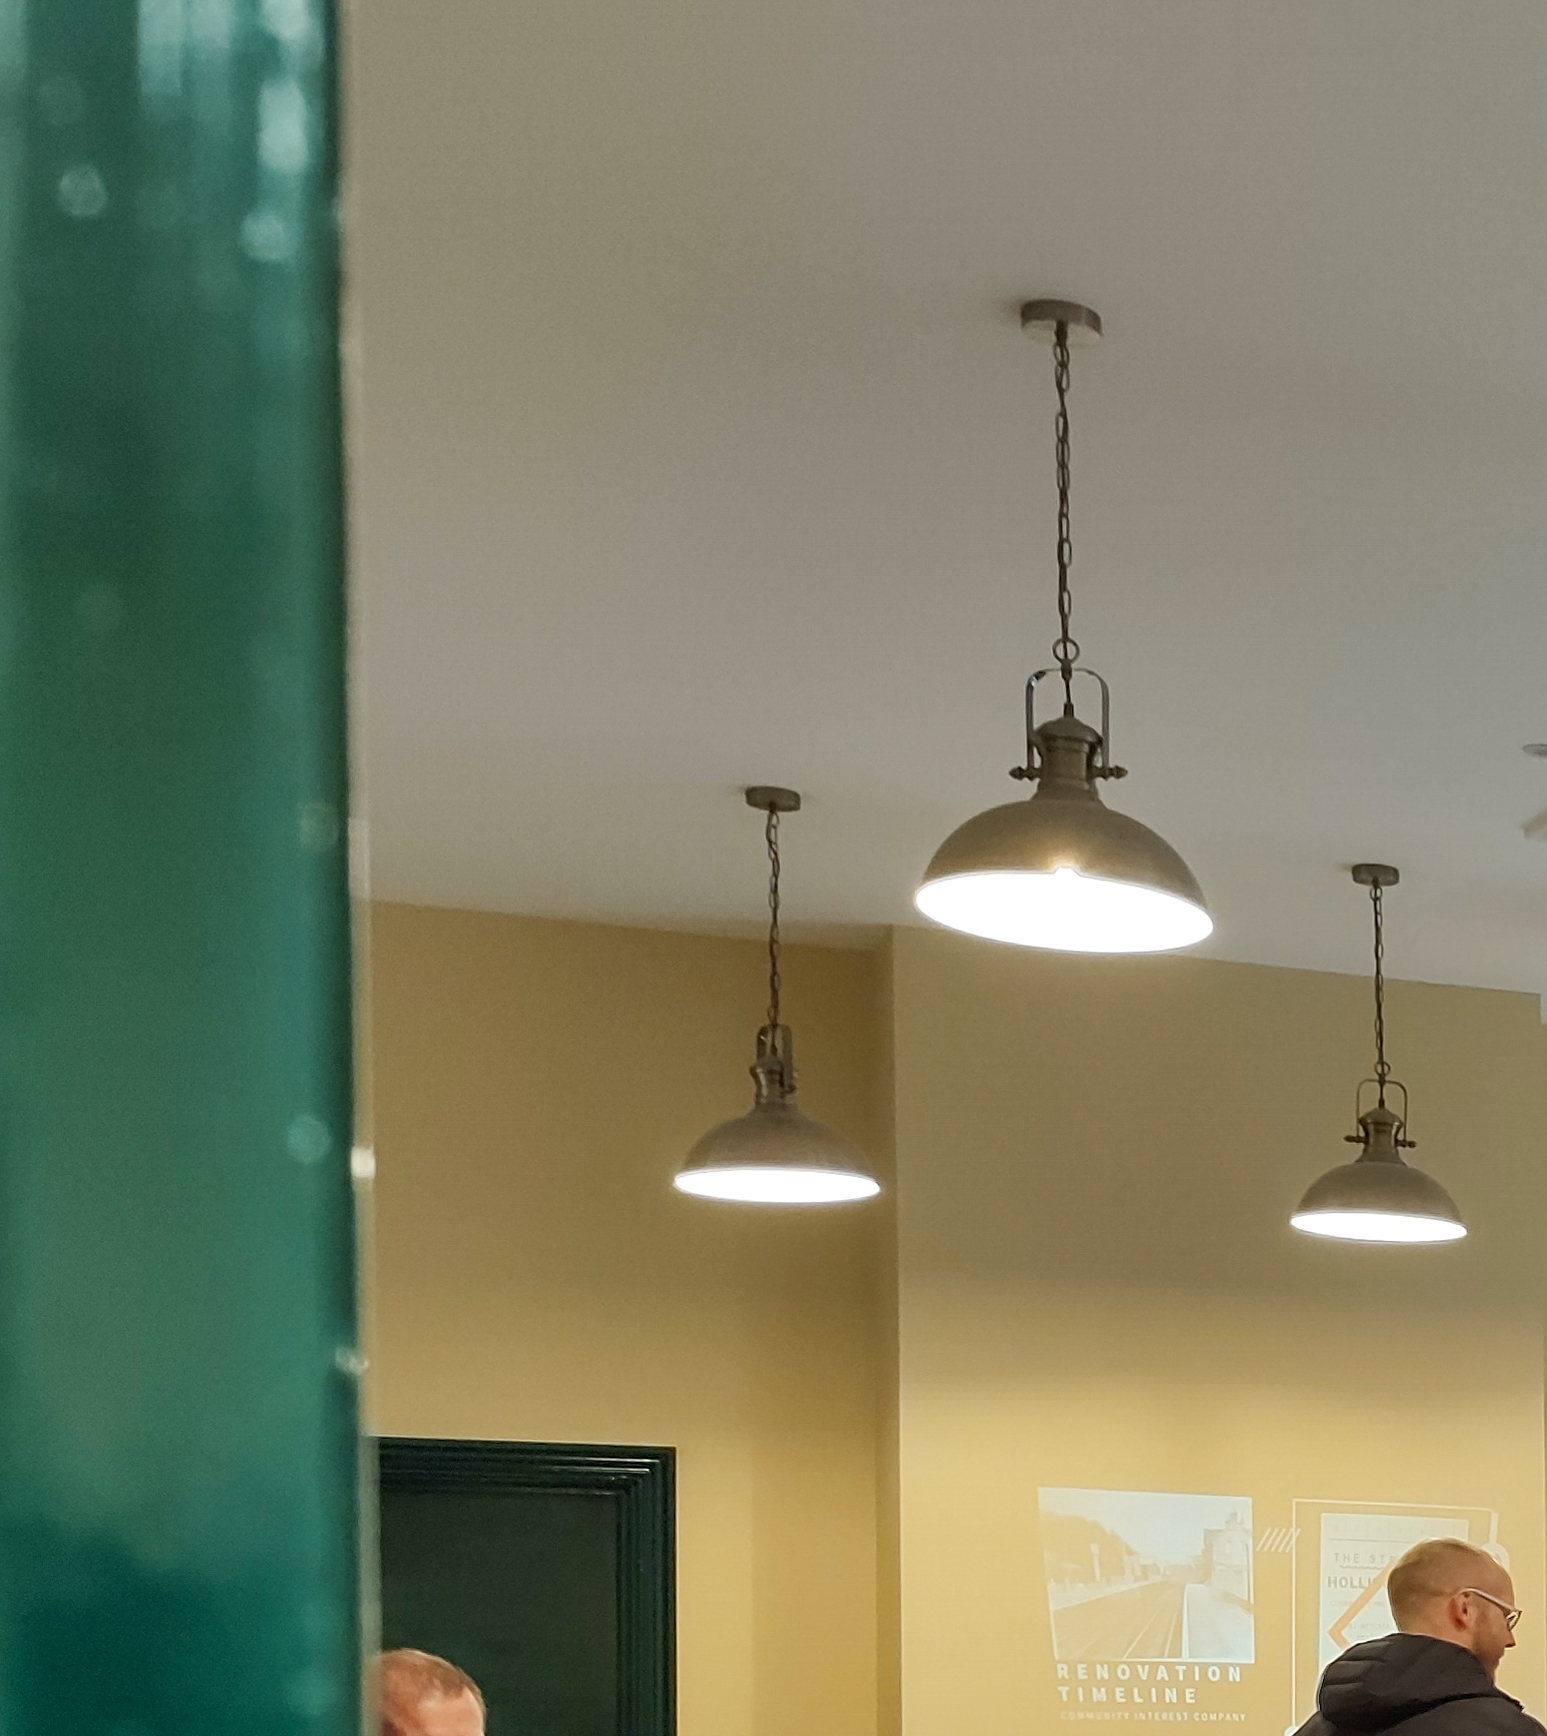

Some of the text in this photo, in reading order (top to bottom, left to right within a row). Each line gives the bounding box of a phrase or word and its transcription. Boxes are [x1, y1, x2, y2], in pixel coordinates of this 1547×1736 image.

[1369, 1553, 1398, 1565] ST
[1056, 1663, 1242, 1683] RENOVATION
[1057, 1686, 1197, 1704] TIMELINE
[1060, 1710, 1247, 1722] COMMUNITY INTEREST COMPANY
